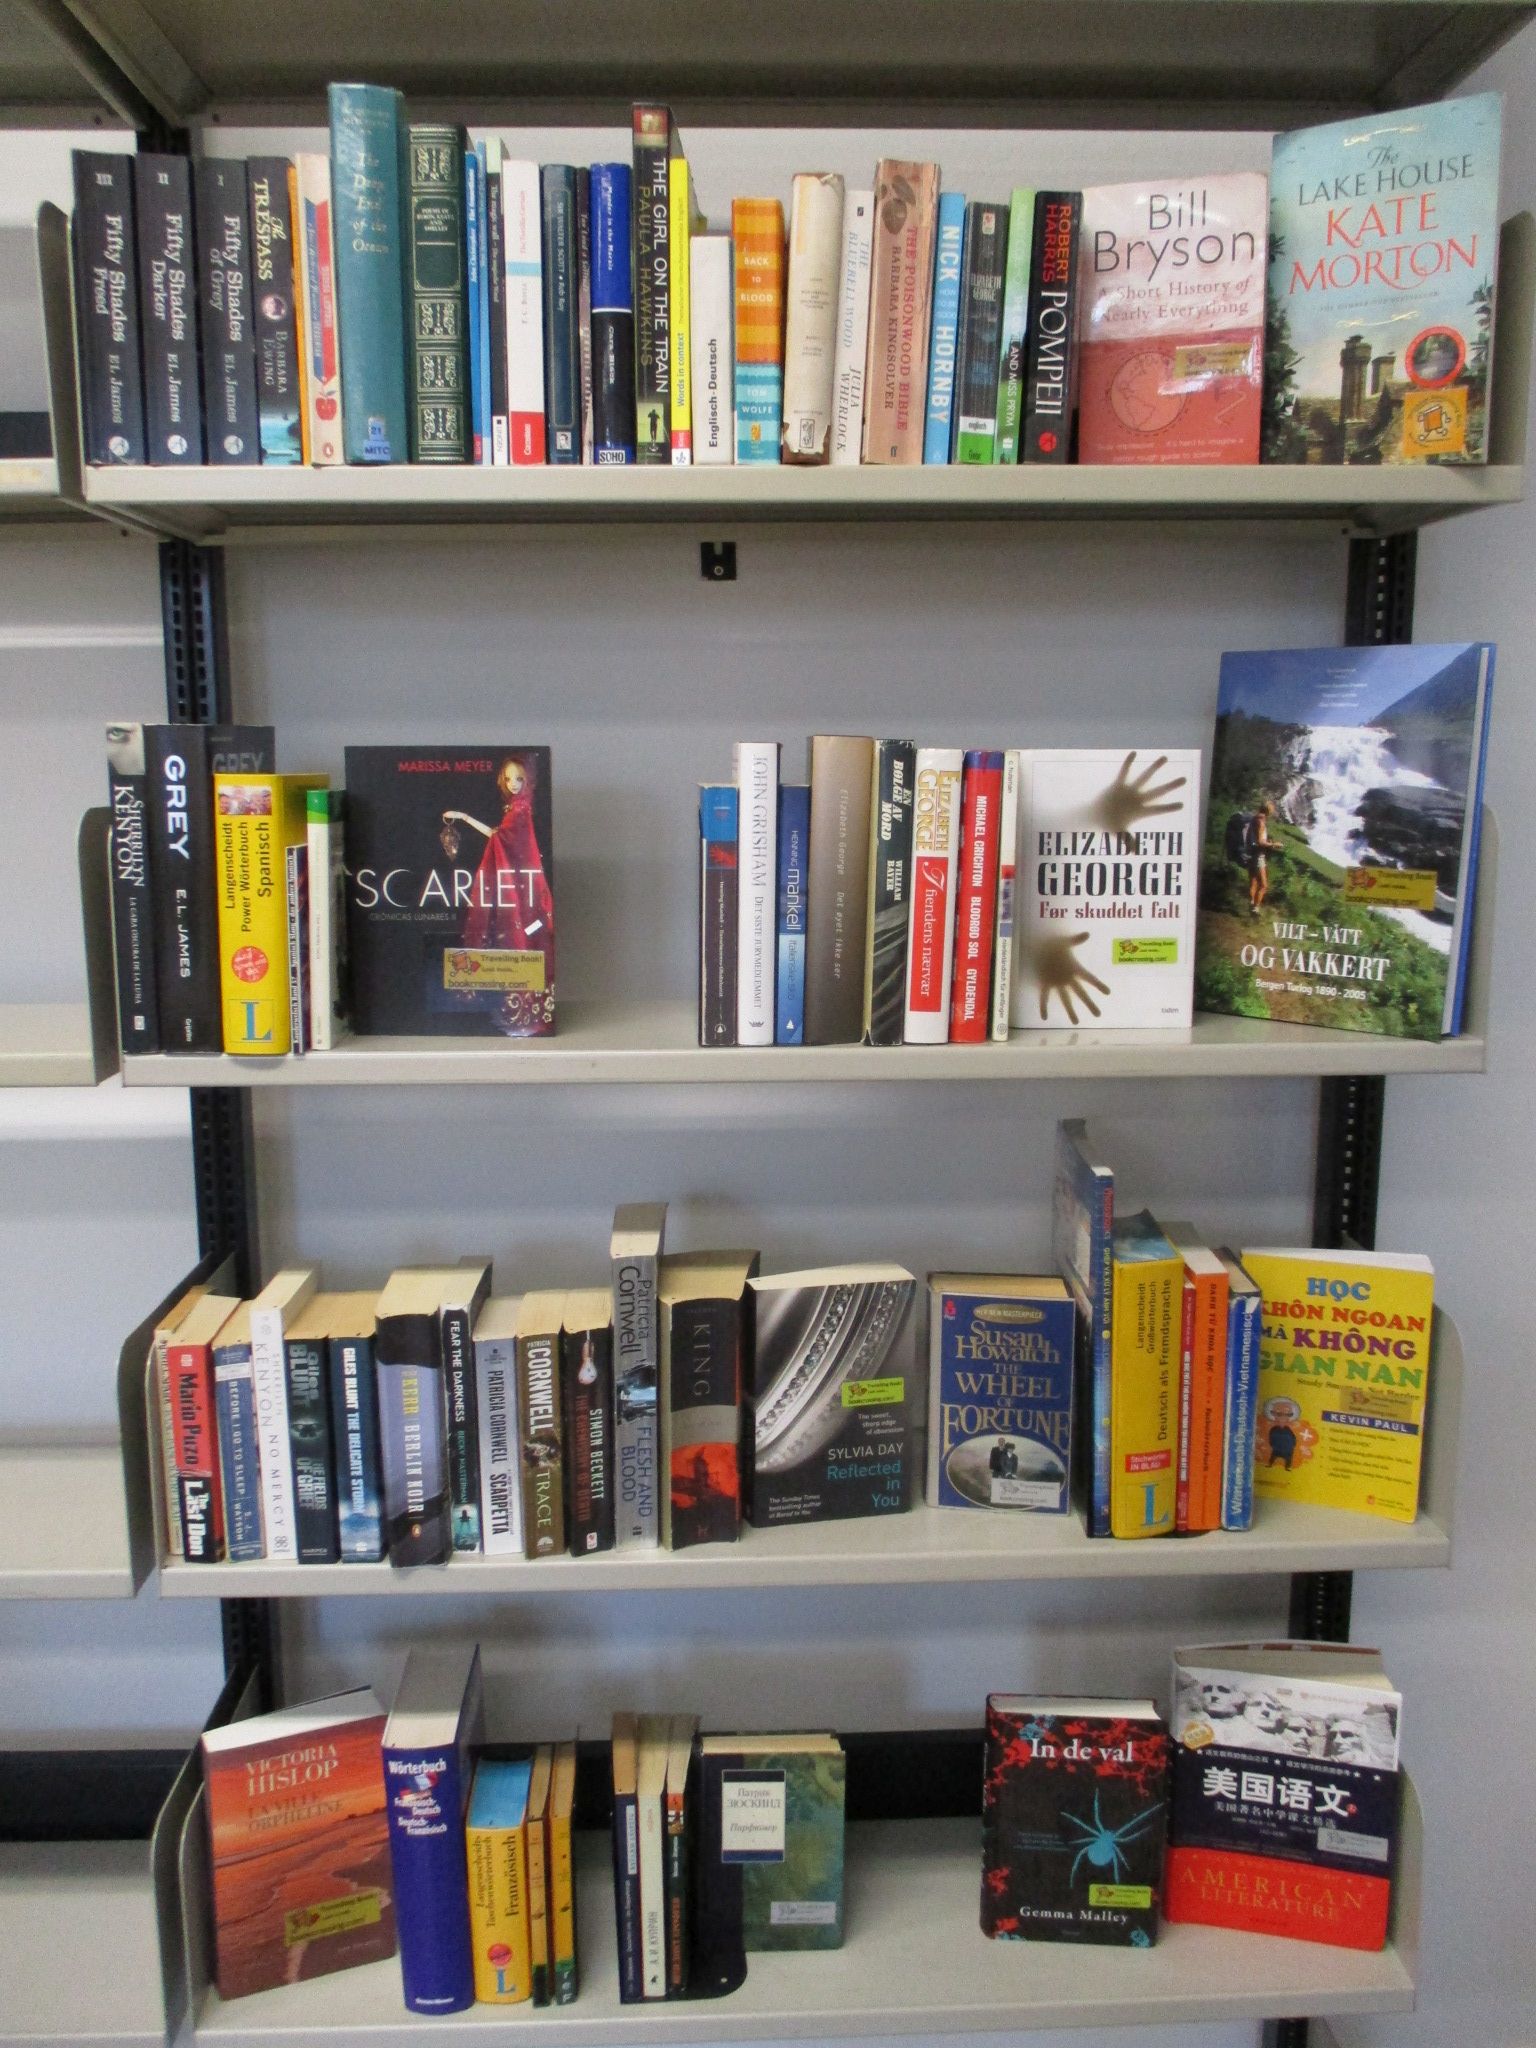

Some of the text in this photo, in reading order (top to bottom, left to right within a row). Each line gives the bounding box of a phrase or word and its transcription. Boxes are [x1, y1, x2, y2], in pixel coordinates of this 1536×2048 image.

[1298, 154, 1475, 206] LAKE HOUSE
[1366, 144, 1402, 169] The
[254, 178, 274, 281] TRESPASS
[270, 216, 287, 241] The
[606, 186, 615, 271] Murder in the Marais
[1149, 189, 1207, 231] Bill
[1326, 192, 1440, 249] KATE
[744, 256, 770, 266] BACK
[939, 225, 960, 282] NICK
[1042, 205, 1059, 283] HARRIS
[1057, 204, 1073, 284] ROBERT
[1094, 231, 1256, 282] Bryson
[1288, 233, 1479, 295] MORTON
[105, 213, 129, 343] Fifty Shades
[151, 259, 168, 322] Darker
[165, 213, 188, 342] Fifty Shades
[223, 214, 243, 343] Fifty Shades
[638, 185, 653, 367] PAULA HAWKINS
[653, 158, 669, 394] THE GIRL ON THE TRAIN
[740, 293, 774, 302] BLOOD
[607, 326, 616, 385] Cara Black
[676, 368, 685, 377] in
[677, 333, 686, 366] context
[930, 325, 955, 424] HORNBY
[1035, 290, 1068, 415] POMPEII
[676, 377, 686, 408] Words
[742, 406, 773, 414] WOLFE
[849, 366, 861, 408] JULIA
[1005, 346, 1020, 426] AND MISS PRYM
[397, 761, 493, 772] MARISSA MEYER
[891, 759, 905, 823] BØLGE AV
[163, 754, 190, 861] GREY
[751, 754, 769, 887] JOHN GRISHAM
[879, 799, 893, 841] MORD
[902, 788, 912, 806] EN
[916, 769, 936, 852] GEORGE
[113, 784, 136, 881] KENYON
[1038, 831, 1185, 857] ELIZABETH
[223, 821, 236, 909] Langenscheidt
[238, 821, 252, 933] Power Wörterbuch
[256, 821, 274, 898] Spanisch
[785, 830, 801, 931] HENNING mankell
[886, 859, 896, 891] BAYER
[894, 859, 904, 902] WILLIAM
[1037, 862, 1183, 897] GEORGE
[355, 868, 545, 908] SCARLET
[964, 795, 988, 1021] MICHAEL CRICHTON BLODRØD SOL GYLDENDAL
[1039, 901, 1181, 919] Før skuddet falt
[1273, 921, 1363, 946] VILT VÅTT
[1240, 944, 1390, 982] OG VAKKERT
[618, 1264, 642, 1357] Cornwell
[636, 1279, 652, 1341] Patricia
[1136, 1282, 1148, 1349] Langenscheidt
[1306, 1277, 1372, 1302] HỌC
[970, 1320, 1044, 1348] Susan
[1146, 1281, 1158, 1355] Großwörterbuch
[450, 1320, 466, 1423] FEAR THE DARKNESS
[692, 1323, 711, 1397] KING
[955, 1371, 1062, 1399] WHEEL
[1157, 1279, 1172, 1441] Deutsch als Fremdsprache
[1260, 1350, 1424, 1390] GIAN NAN
[228, 1380, 242, 1419] BEFORE
[487, 1369, 508, 1464] PATRICIA CORNWELL
[527, 1346, 554, 1436] CORNWELL
[997, 1397, 1015, 1408] OF
[179, 1372, 203, 1466] Mario Puzo
[231, 1431, 242, 1444] GO
[940, 1402, 1071, 1462] FORTUNE
[1330, 1413, 1408, 1433] KEVIN PAUL
[233, 1448, 242, 1461] TO
[402, 1378, 425, 1514] KERR BERLIN NOIR
[456, 1430, 468, 1504] BECKY MASTERMAN
[589, 1408, 605, 1500] SIMON BECKETT
[827, 1460, 901, 1480] Reflected
[828, 1442, 904, 1461] SYLVIA DAY
[233, 1464, 245, 1496] SLEEP
[621, 1445, 637, 1503] BLOOD
[635, 1426, 653, 1519] FLESH AND
[886, 1477, 900, 1491] in
[183, 1480, 206, 1556] Last Don
[198, 1493, 210, 1511] The
[233, 1502, 243, 1541] WATSON
[490, 1473, 510, 1536] SCARPETTA
[536, 1470, 552, 1529] TRACE
[871, 1493, 899, 1508] You
[246, 1743, 338, 1776] VICTORIA
[388, 1757, 447, 1775] Wörterbuch
[1030, 1738, 1134, 1763] In de val
[248, 1759, 340, 1798] HISLOP
[728, 1798, 782, 1810] ЗЮСКИНД
[1202, 1766, 1351, 1818] 美国语文
[729, 1823, 778, 1834] Парфюмер
[502, 1834, 520, 1917] Französisch
[1180, 1866, 1365, 1911] AMERICAN
[1019, 1906, 1129, 1925] Gemma Malley
[1201, 1887, 1338, 1921] LITERATURE
